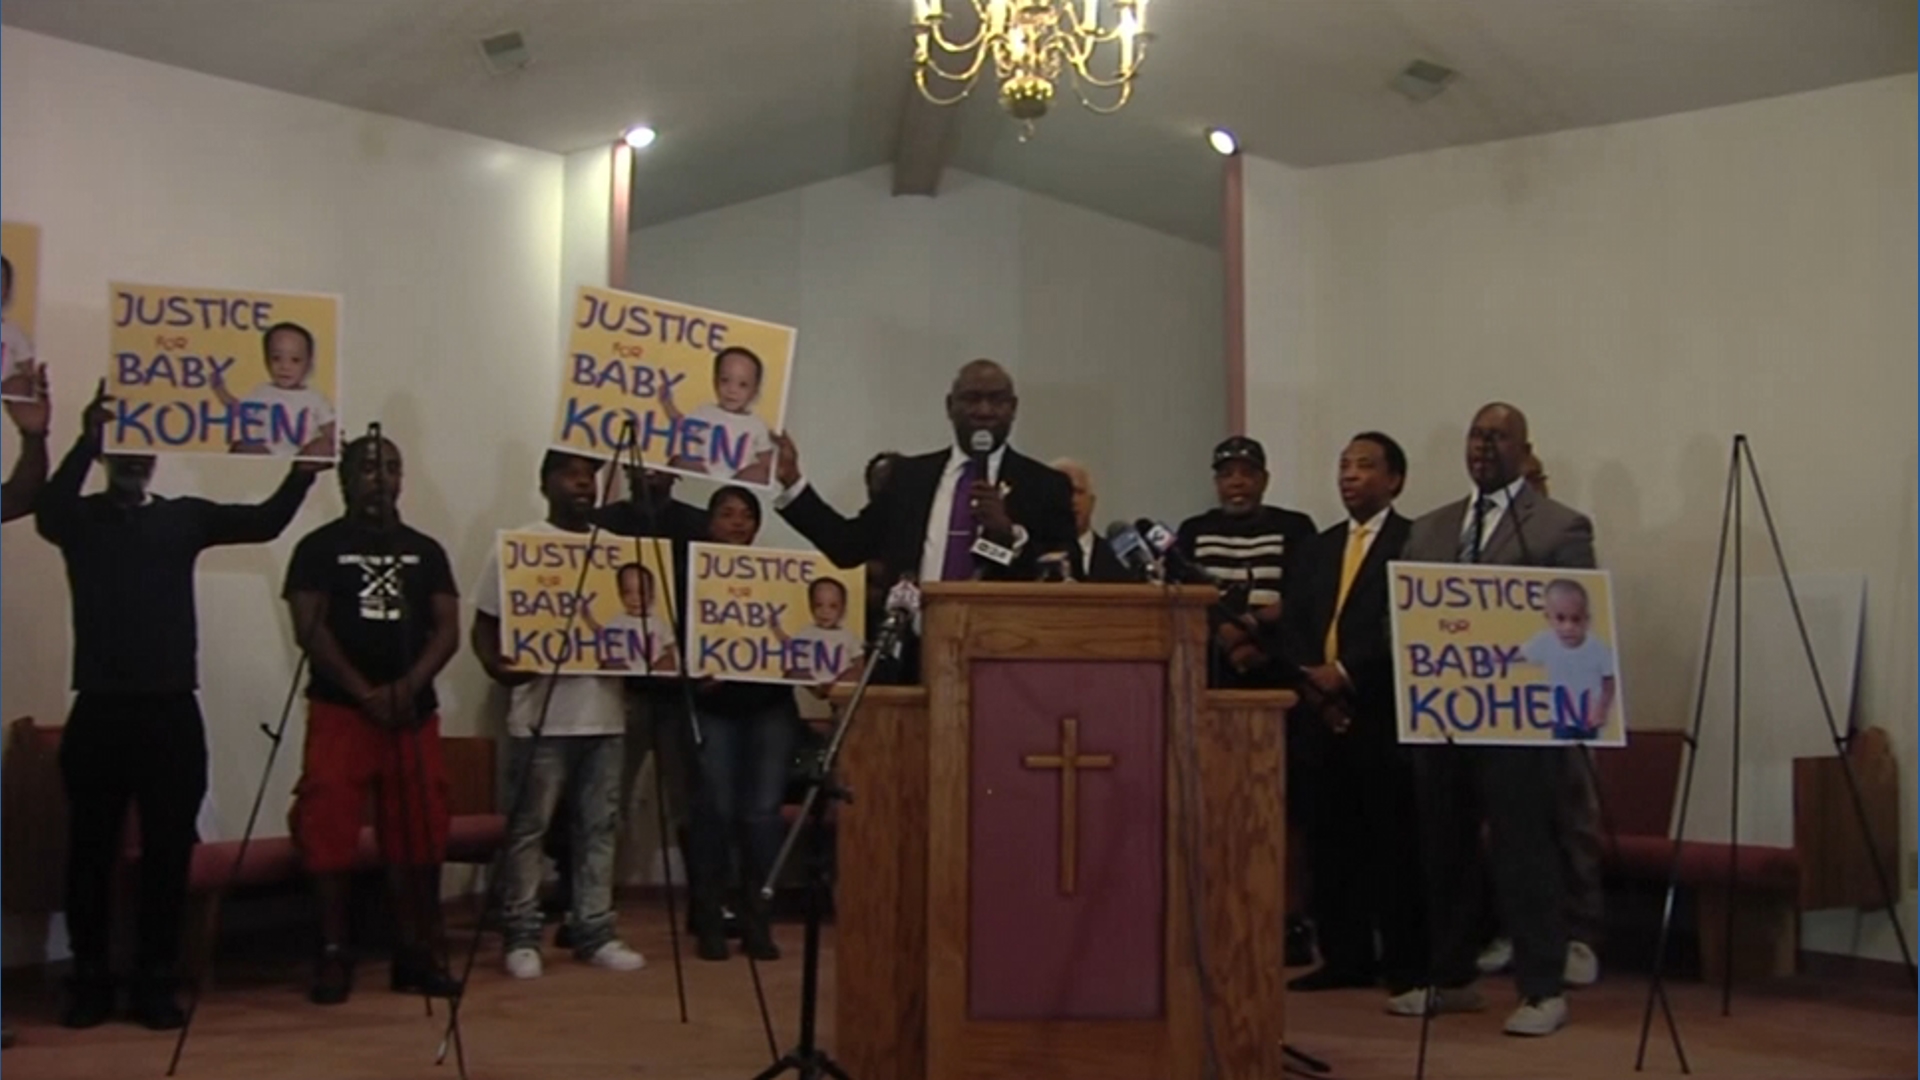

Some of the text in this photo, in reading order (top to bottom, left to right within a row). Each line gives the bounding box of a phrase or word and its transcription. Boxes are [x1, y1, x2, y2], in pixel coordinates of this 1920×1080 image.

[115, 292, 274, 331] JUSTICE
[577, 294, 729, 354] JUSTICE
[155, 335, 189, 351] FOR
[612, 342, 644, 359] FOR
[115, 352, 235, 389] BABY
[572, 353, 685, 402] BABY
[115, 399, 309, 446] KOHEN
[561, 397, 749, 470] KOHEN
[697, 552, 816, 584] JUSTICE
[509, 589, 598, 617] BABY
[1397, 574, 1546, 611] JUSTICE
[698, 599, 787, 628] BABY
[1438, 618, 1471, 634] FOR
[513, 627, 656, 665] KOHEN
[699, 635, 843, 674] KOHEN
[1406, 643, 1521, 679] BABY
[1408, 683, 1591, 732] KOHEN
